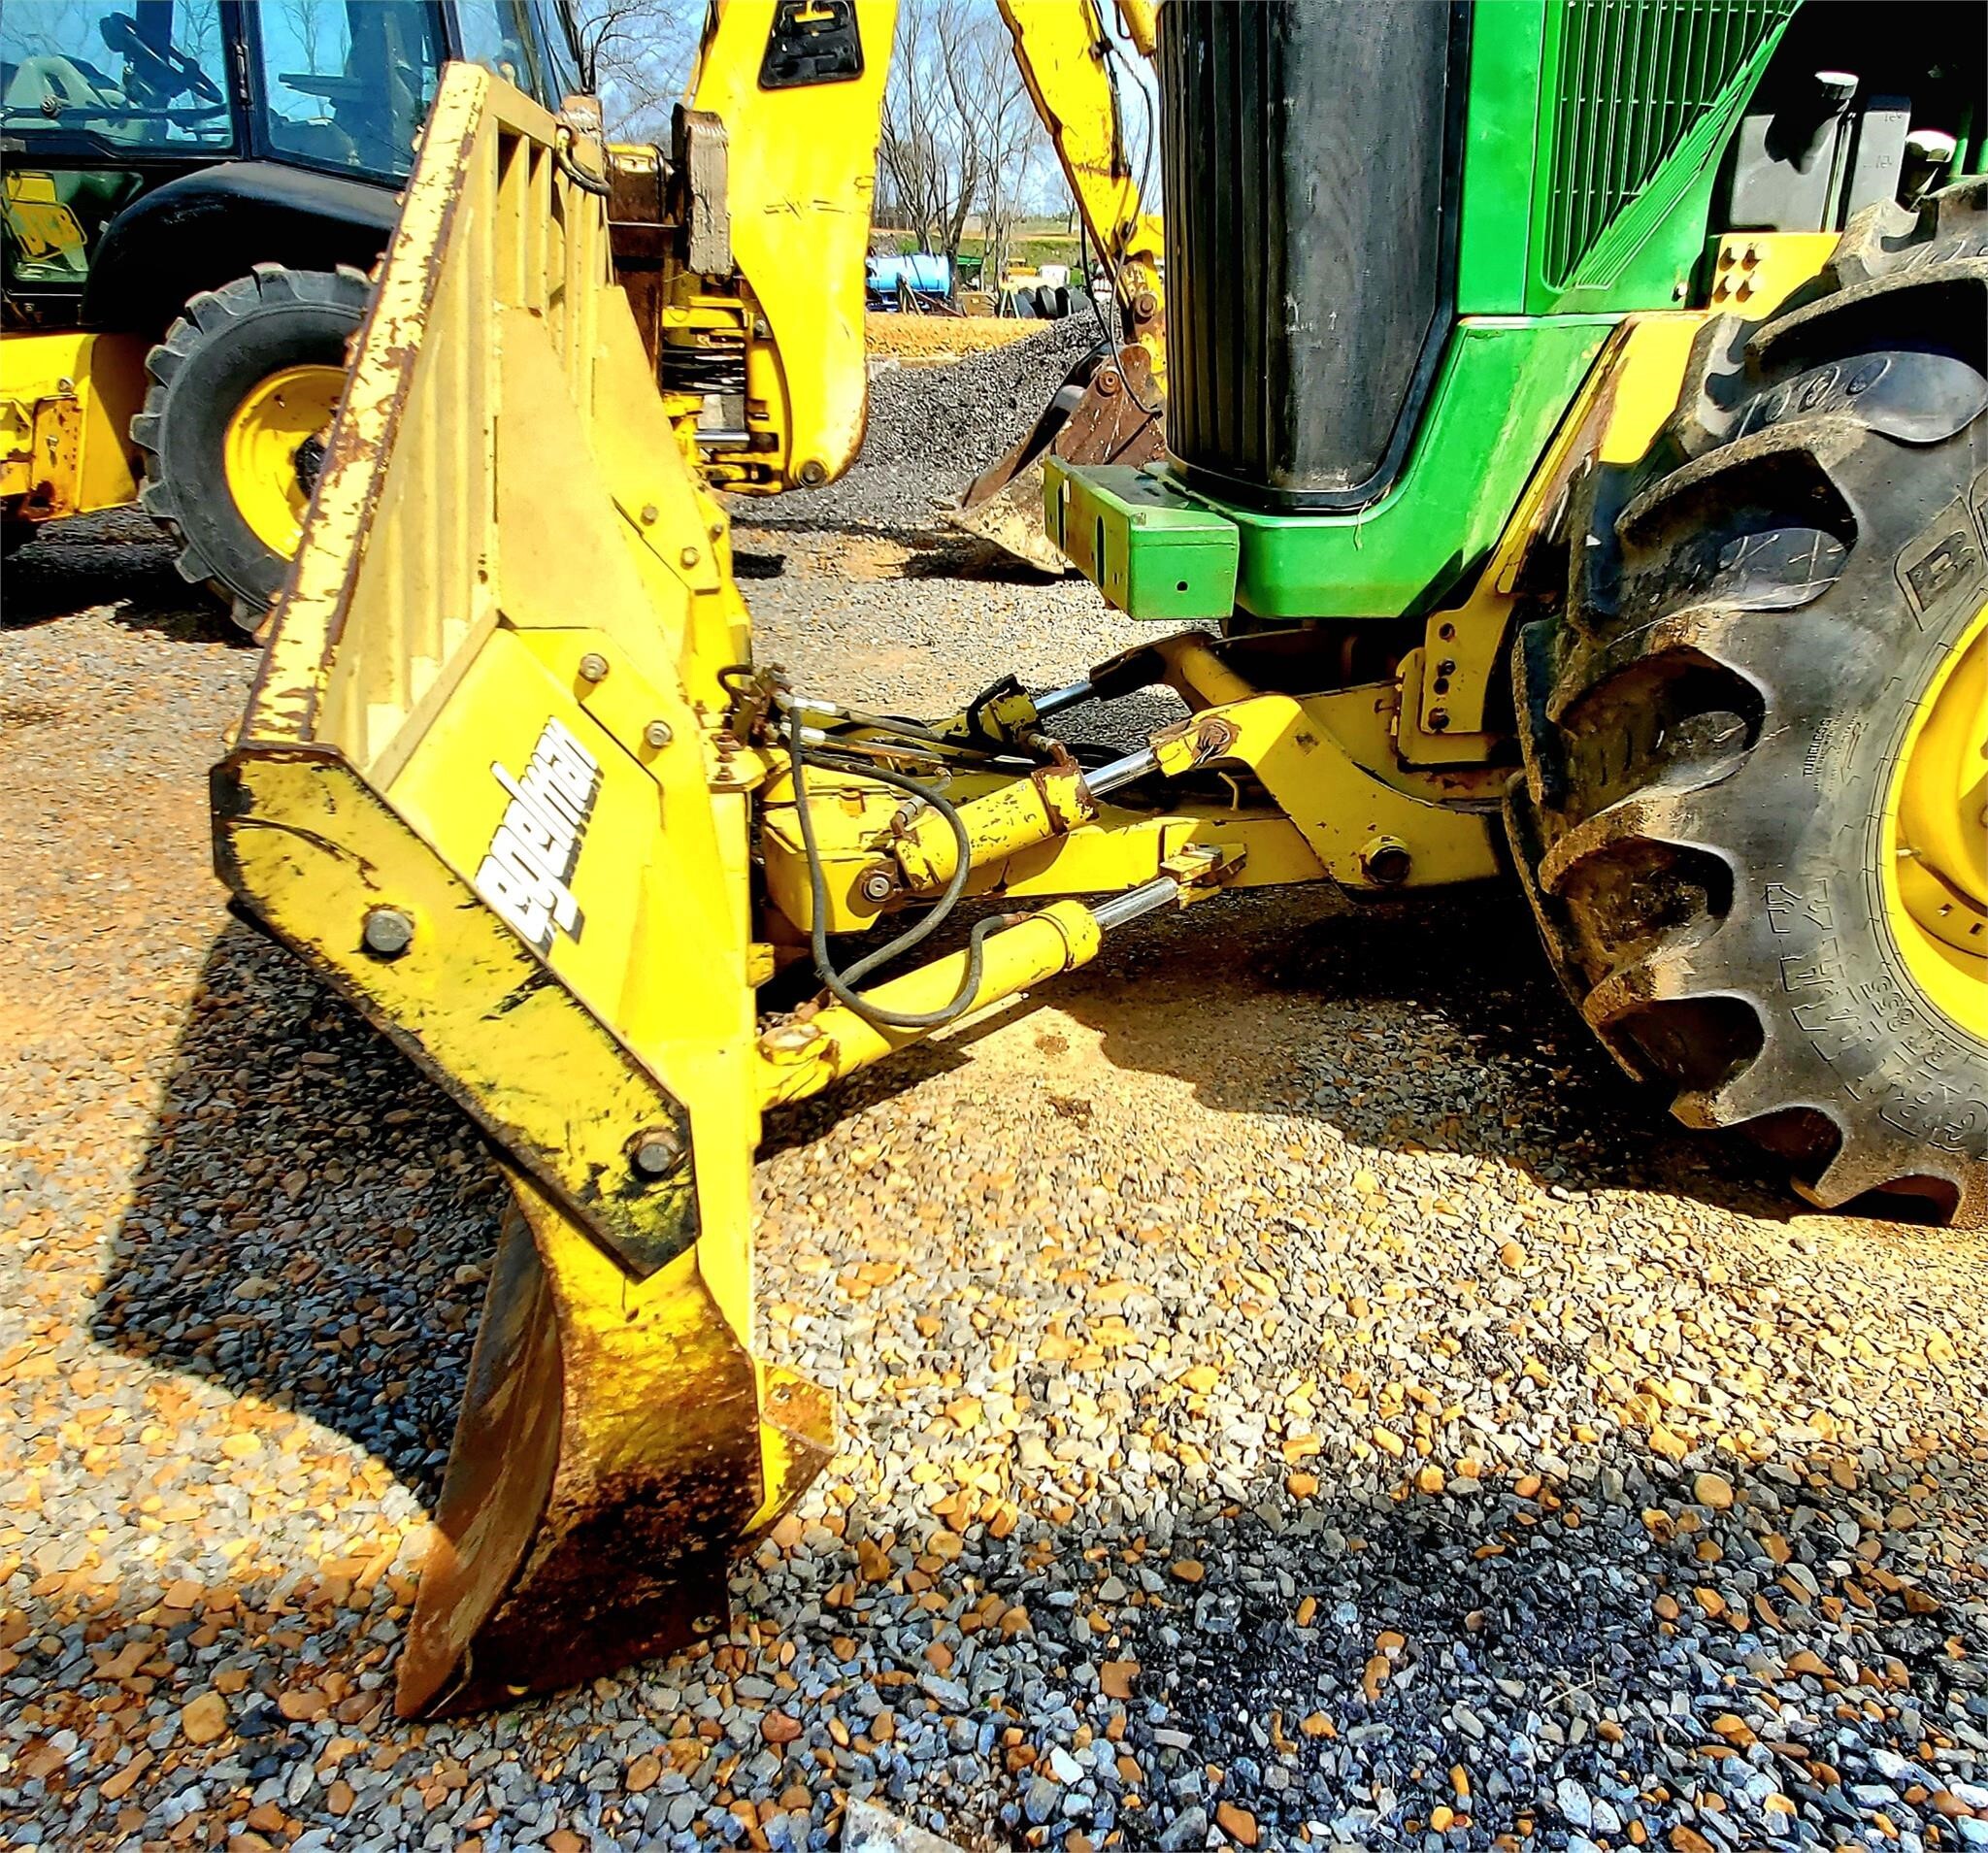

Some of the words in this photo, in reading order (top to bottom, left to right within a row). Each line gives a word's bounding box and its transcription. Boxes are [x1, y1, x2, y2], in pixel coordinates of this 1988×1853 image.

[475, 714, 605, 951] egelman
[1802, 717, 1833, 778] TUBELESS
[1765, 877, 1988, 1161] GRIMAX
